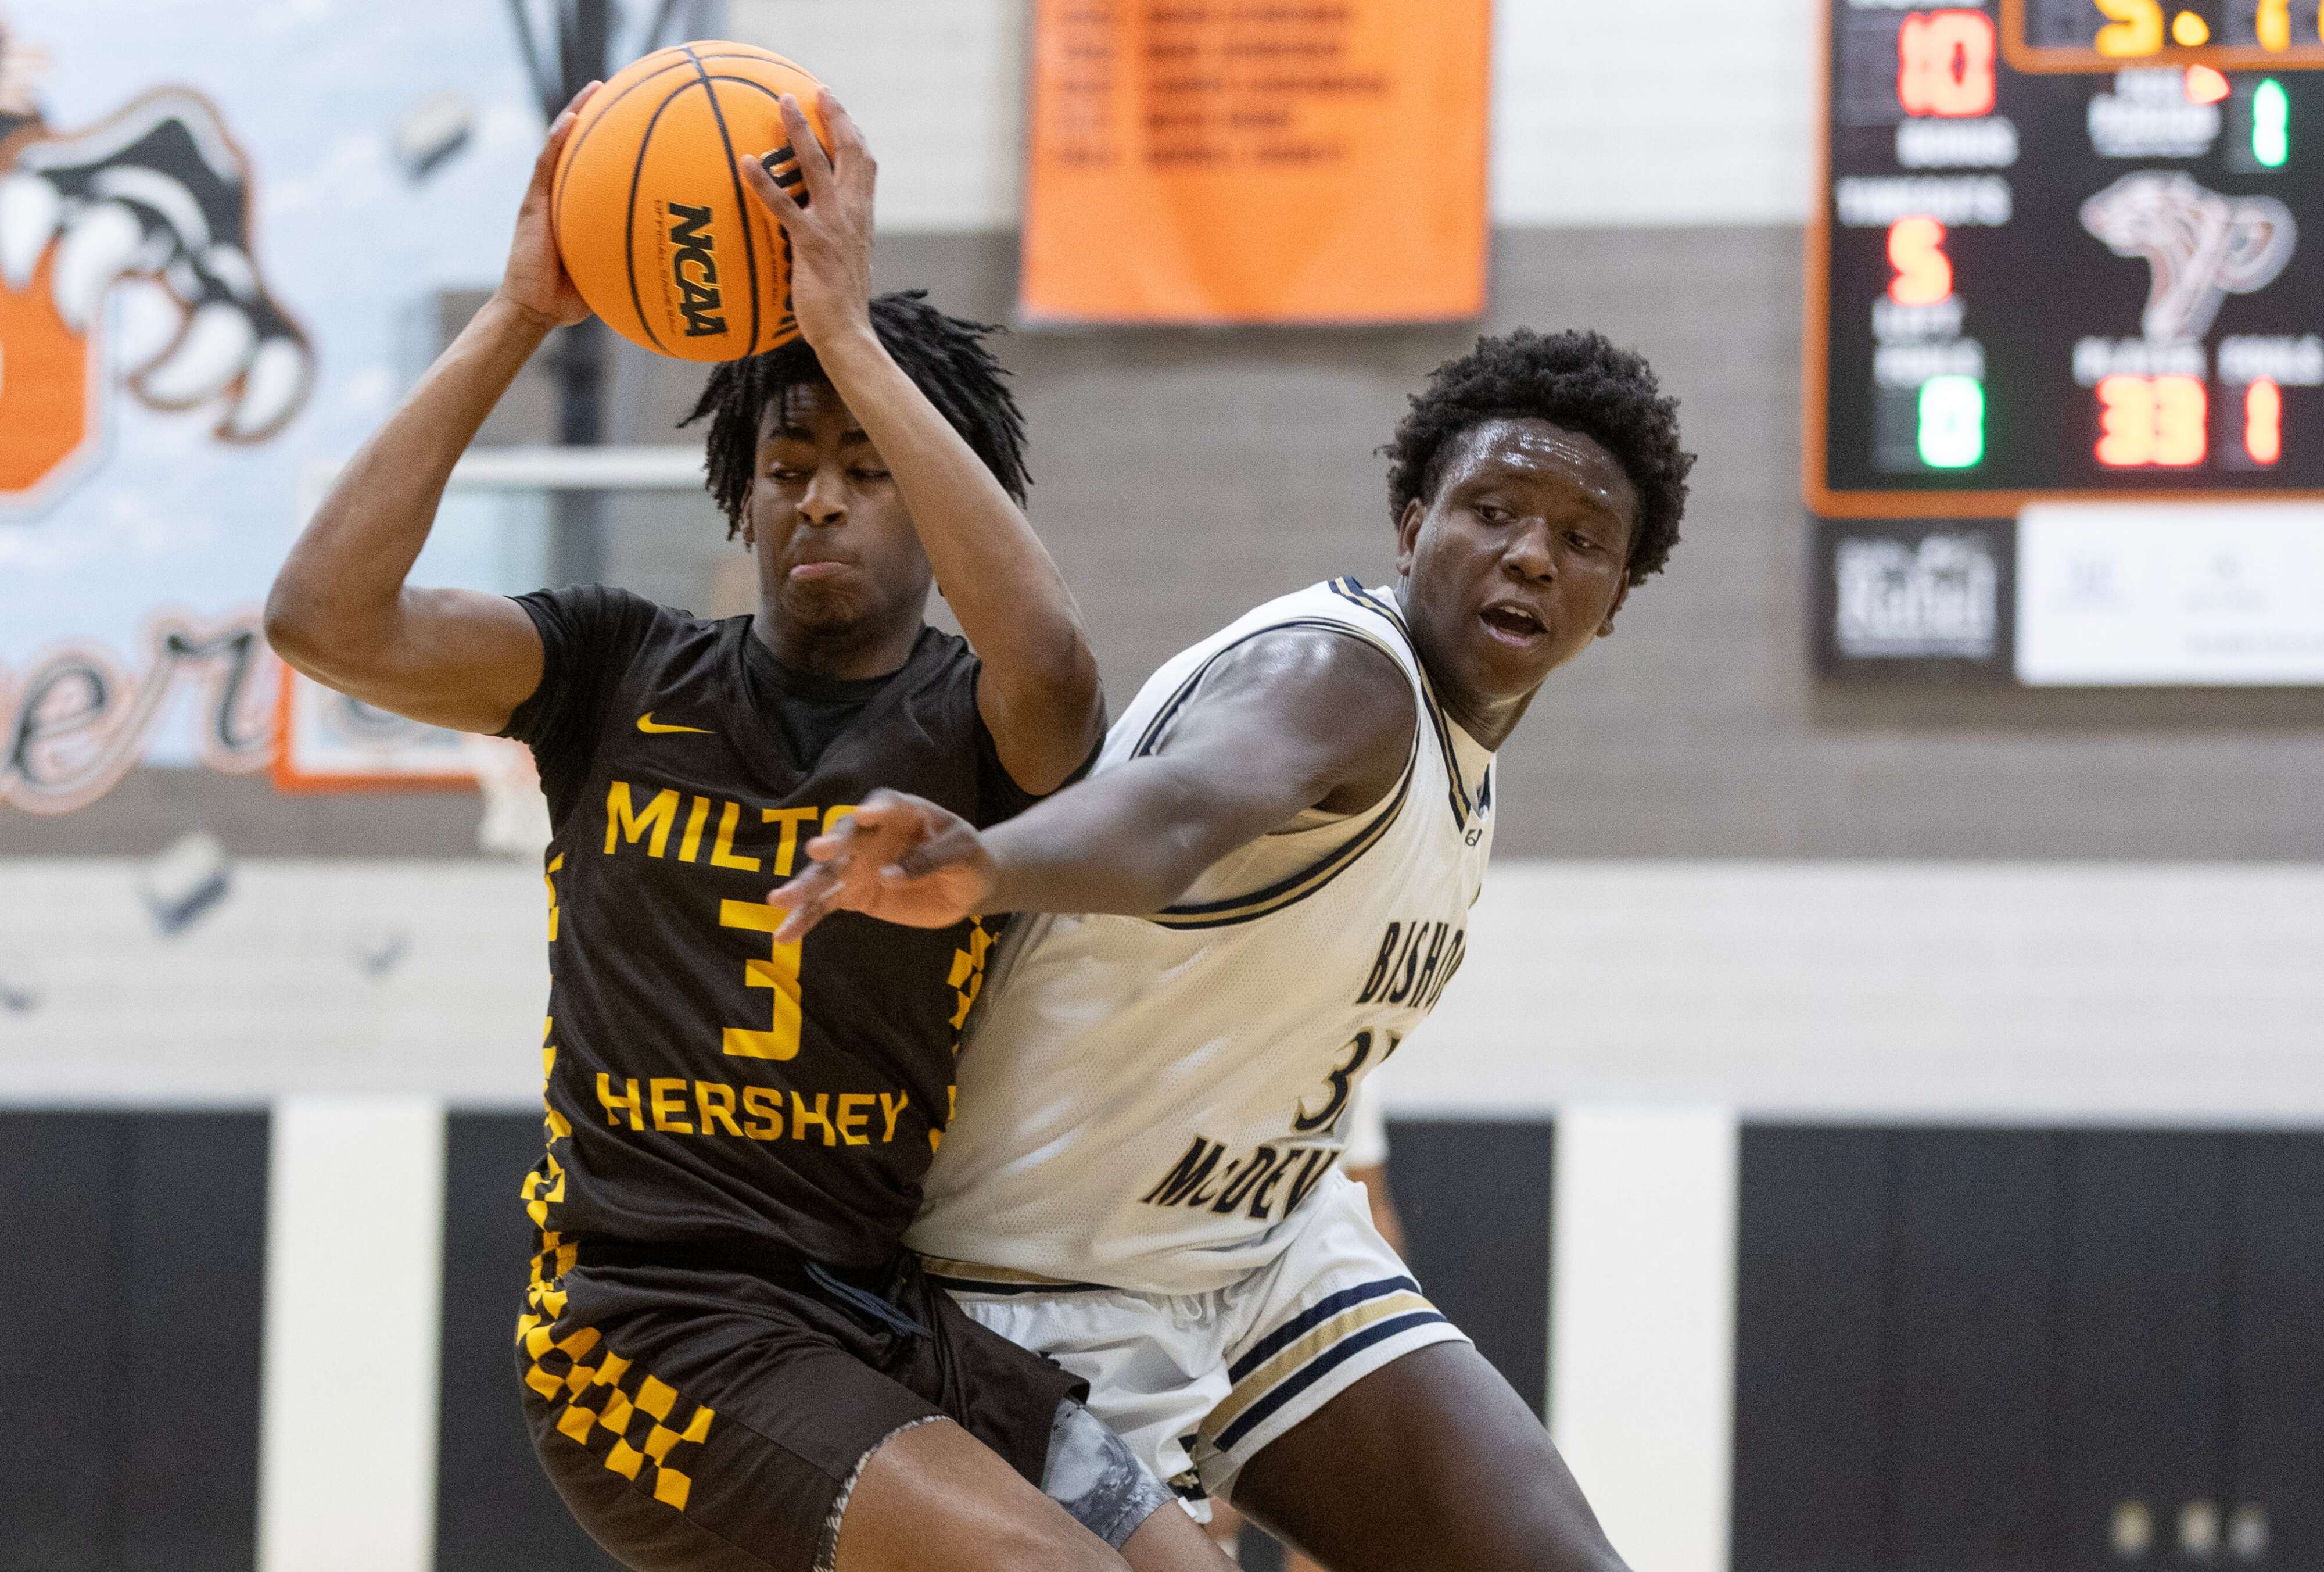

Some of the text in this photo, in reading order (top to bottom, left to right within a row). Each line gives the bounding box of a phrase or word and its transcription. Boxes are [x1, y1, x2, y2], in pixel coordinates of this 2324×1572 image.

[669, 202, 728, 337] NCAA
[1887, 214, 1953, 307] 5
[720, 898, 803, 1061] 3
[596, 1072, 909, 1147] HERSHEY
[1292, 1026, 1403, 1133] 3
